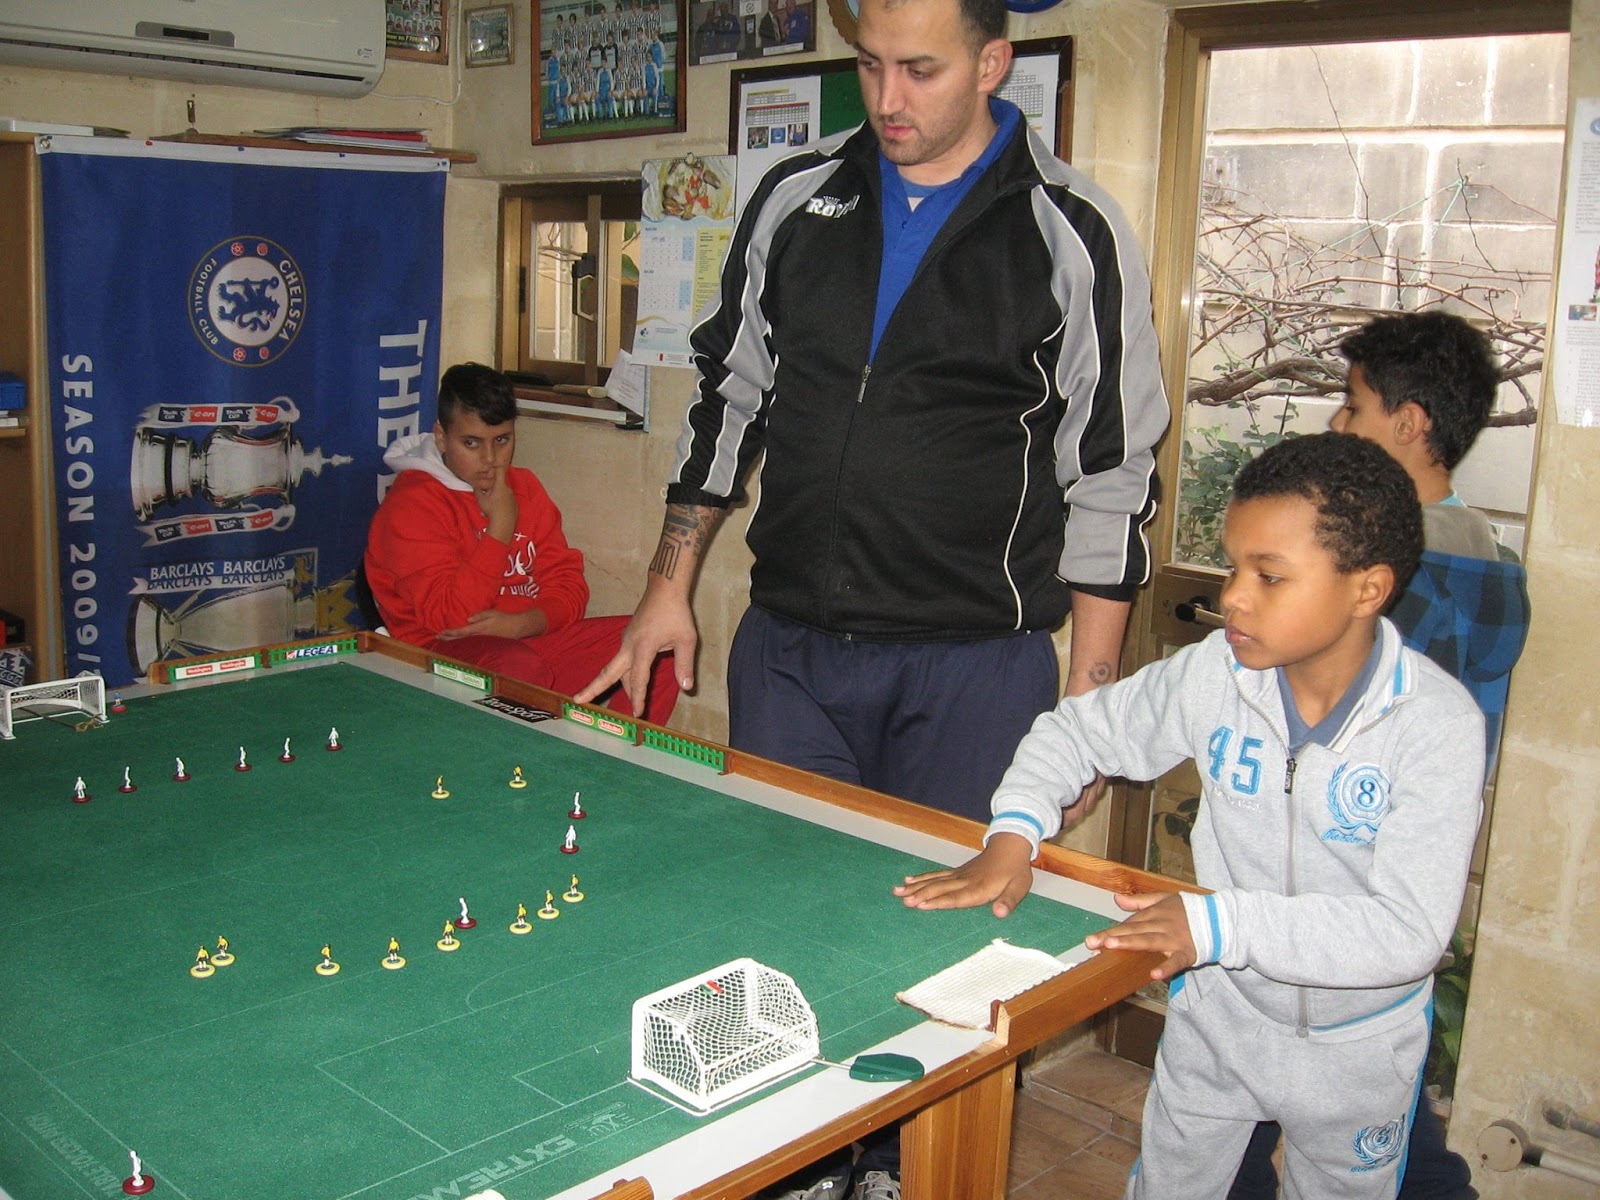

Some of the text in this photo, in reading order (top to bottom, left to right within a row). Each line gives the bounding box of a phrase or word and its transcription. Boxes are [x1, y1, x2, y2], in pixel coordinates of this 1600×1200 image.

[195, 258, 219, 345] FOOTBALL CLUB
[279, 260, 302, 341] CHELSEA
[377, 319, 428, 448] THE
[62, 353, 101, 677] SEASON 2009/
[150, 556, 286, 581] BARCLAYS BARCLAYS
[296, 645, 335, 658] LEGEA
[1207, 725, 1264, 796] 45
[1357, 778, 1376, 808] 8
[405, 1134, 578, 1200] EXTREM
